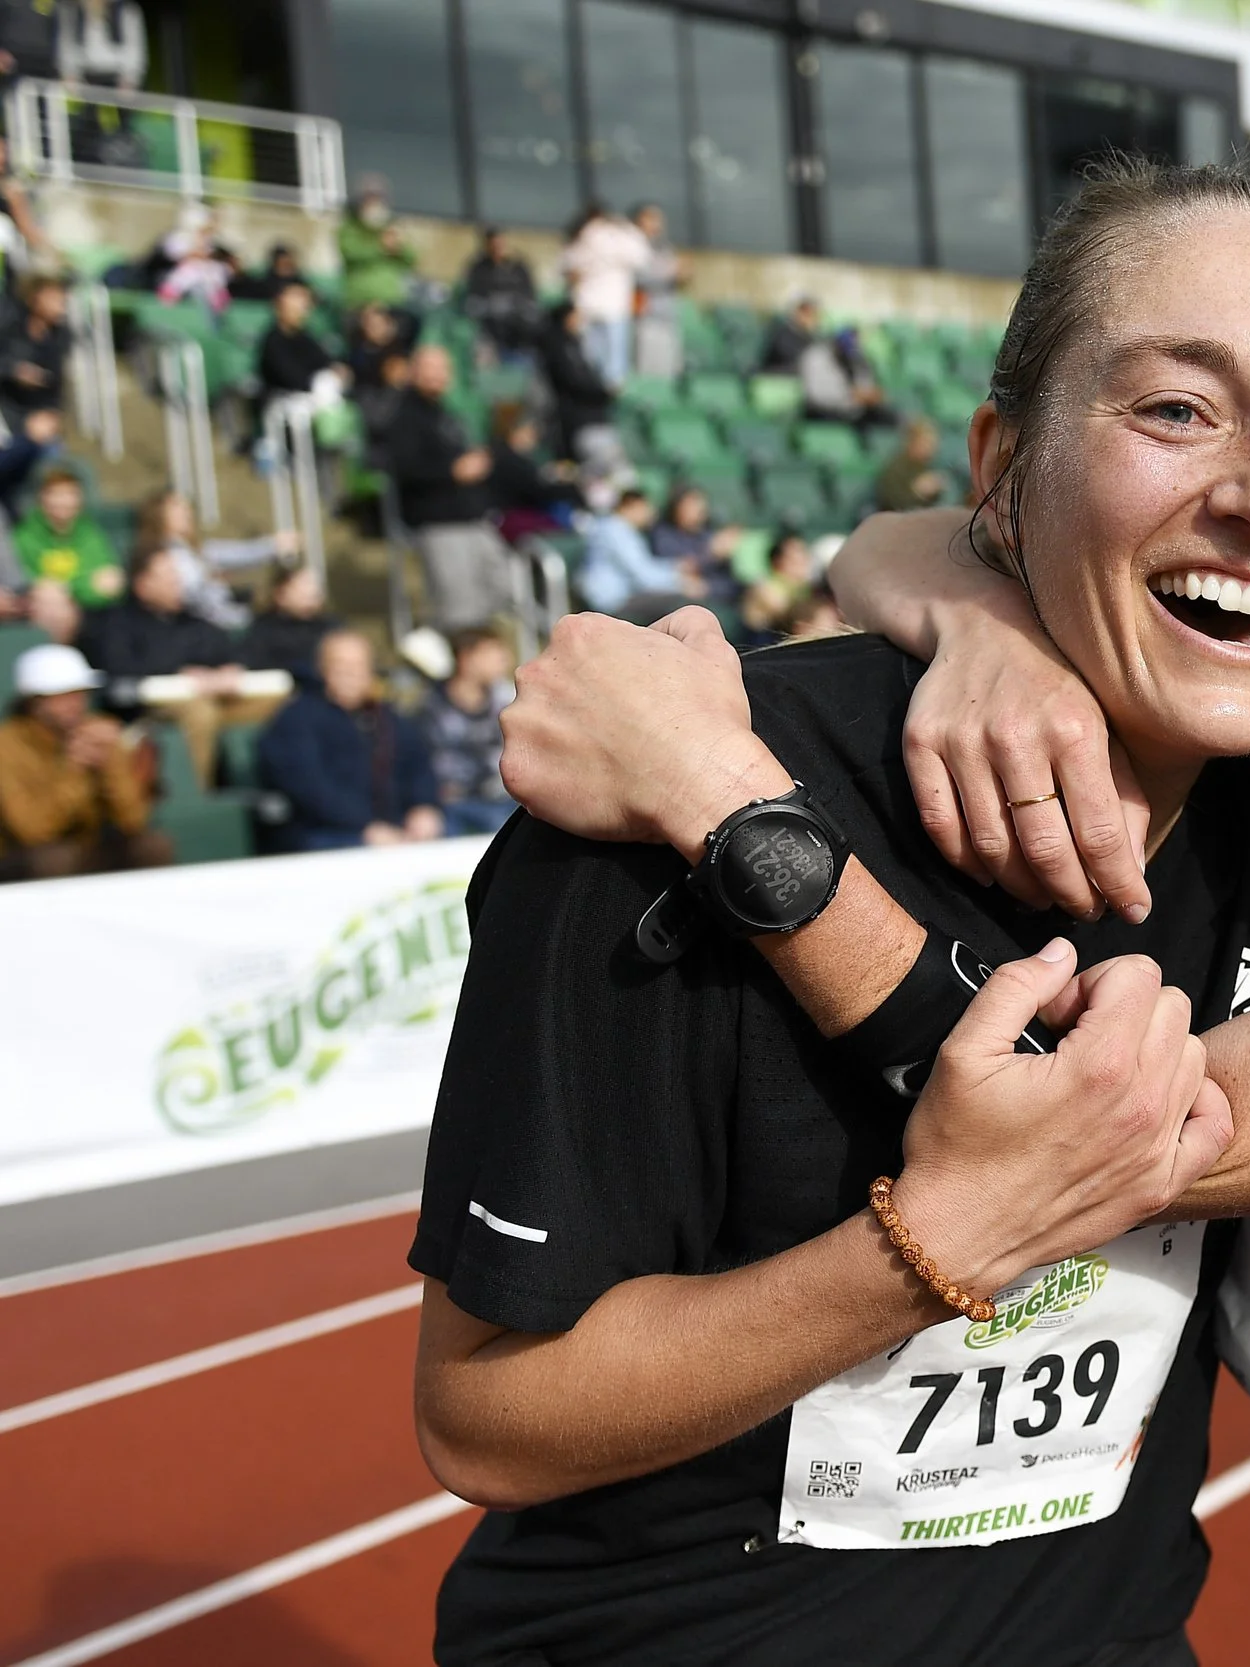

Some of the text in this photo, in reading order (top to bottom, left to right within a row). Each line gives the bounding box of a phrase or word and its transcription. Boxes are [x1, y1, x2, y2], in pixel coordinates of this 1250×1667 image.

[219, 904, 470, 1094] EUGENE
[1043, 1257, 1075, 1286] 2024
[1162, 1238, 1173, 1256] B
[989, 1262, 1092, 1336] EUGENE
[897, 1339, 1120, 1456] 7139
[896, 1466, 979, 1493] KRUSTEAZ
